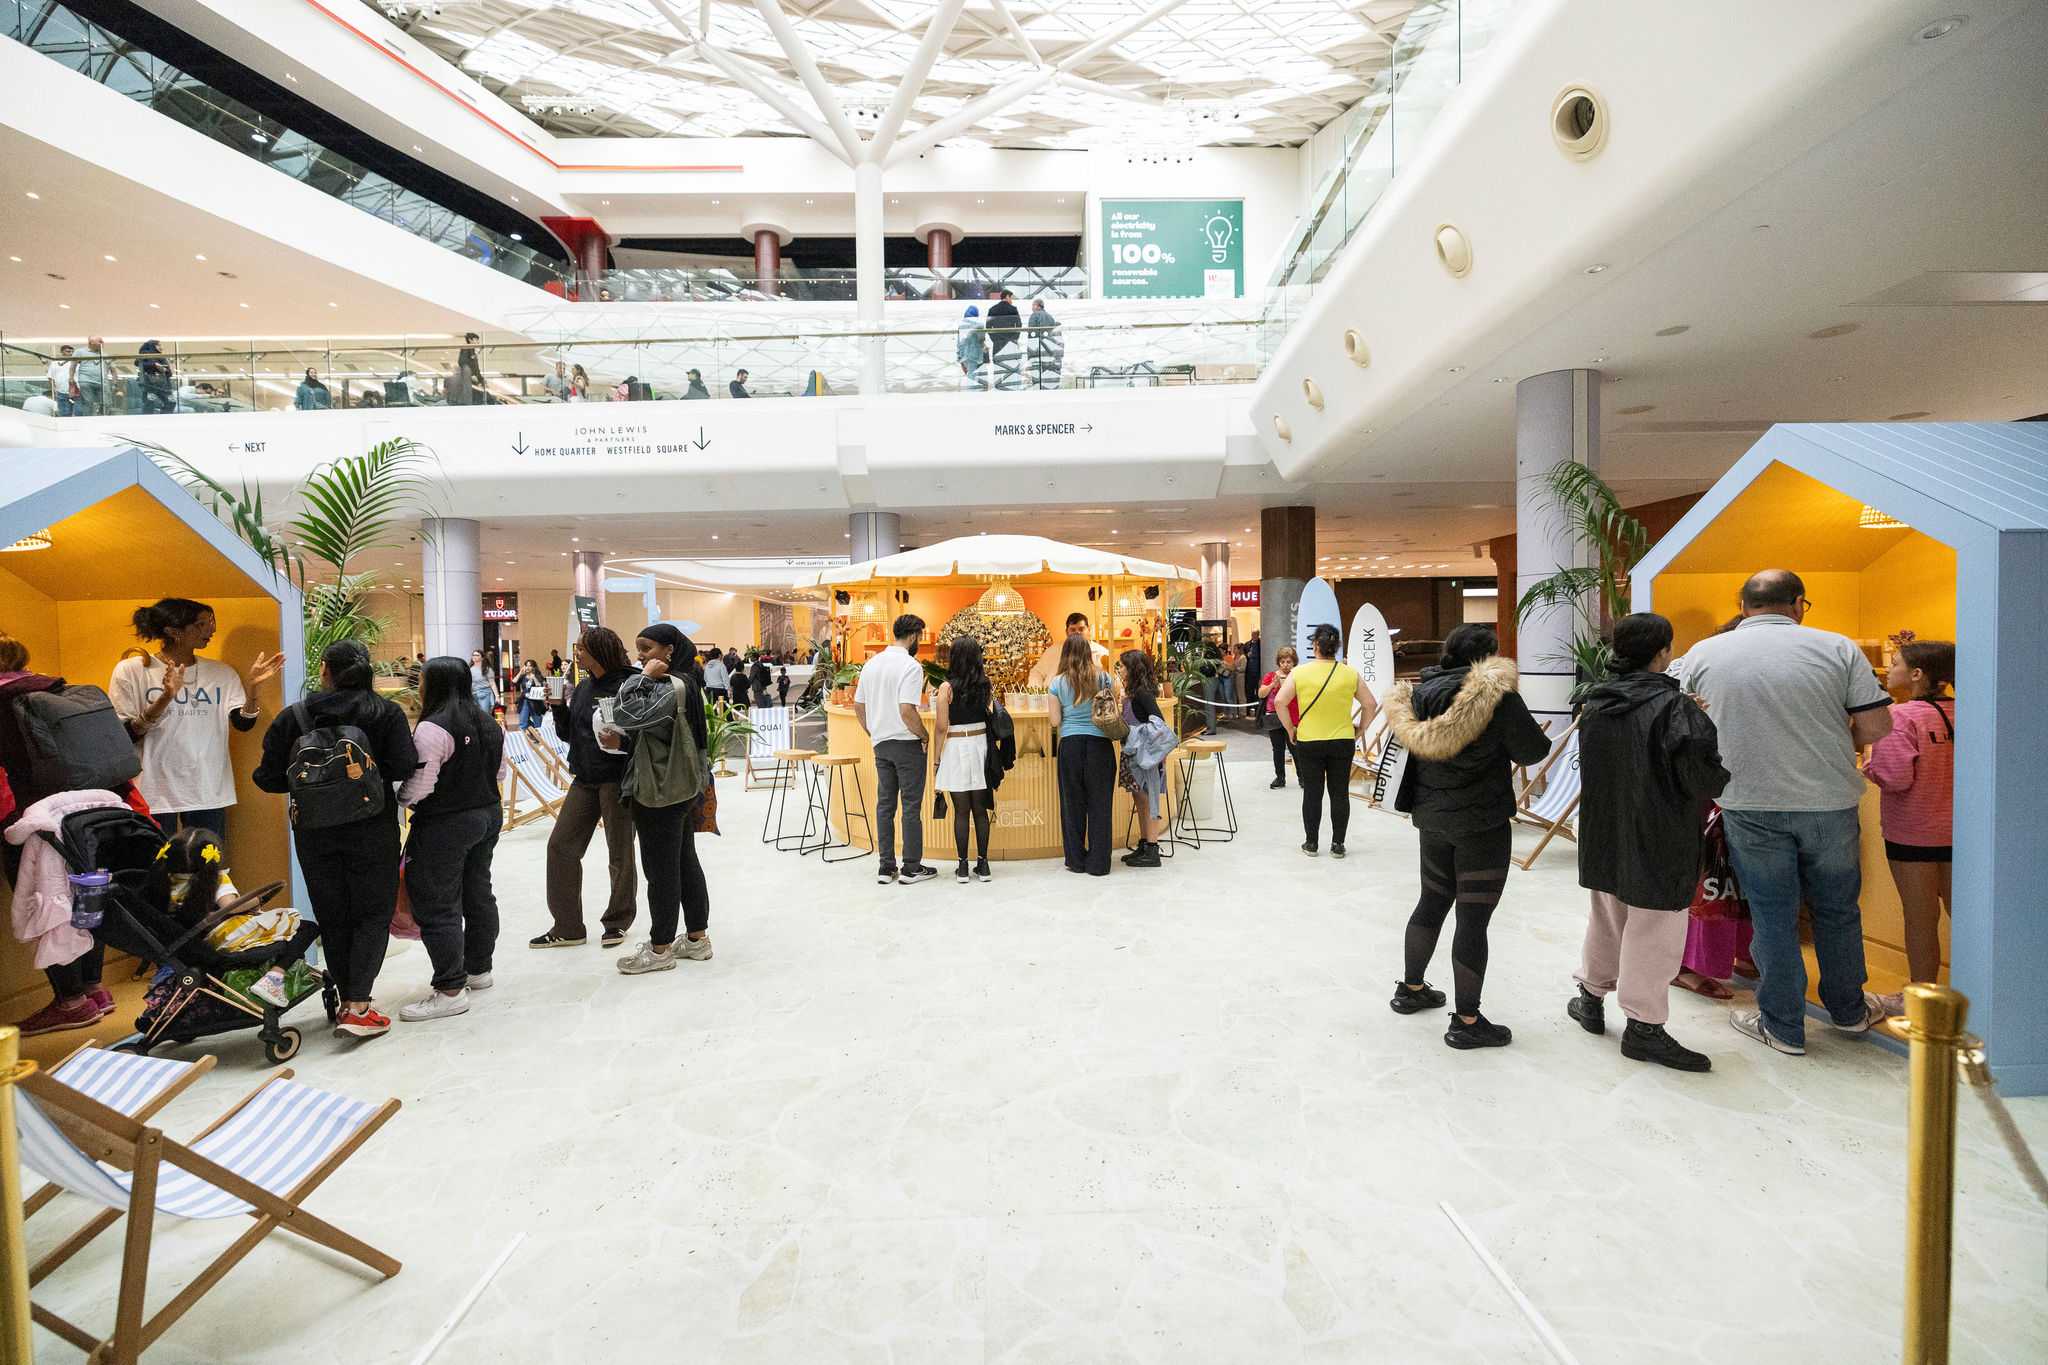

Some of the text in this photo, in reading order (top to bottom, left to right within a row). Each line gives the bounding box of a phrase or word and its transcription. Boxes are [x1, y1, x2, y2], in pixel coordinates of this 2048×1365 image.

[1111, 211, 1123, 221] All
[1111, 221, 1156, 231] electricity
[1111, 230, 1142, 238] is from
[1112, 243, 1176, 264] 100%
[1112, 267, 1158, 276] renewable
[575, 426, 647, 436] JOHN LEWIS
[995, 423, 1075, 436] MARKS & SPENCER
[244, 442, 266, 452] NEXT
[535, 447, 596, 456] HOME QUARTER
[606, 444, 688, 454] WESTFIELD SQUARE
[484, 610, 516, 618] TUDOR
